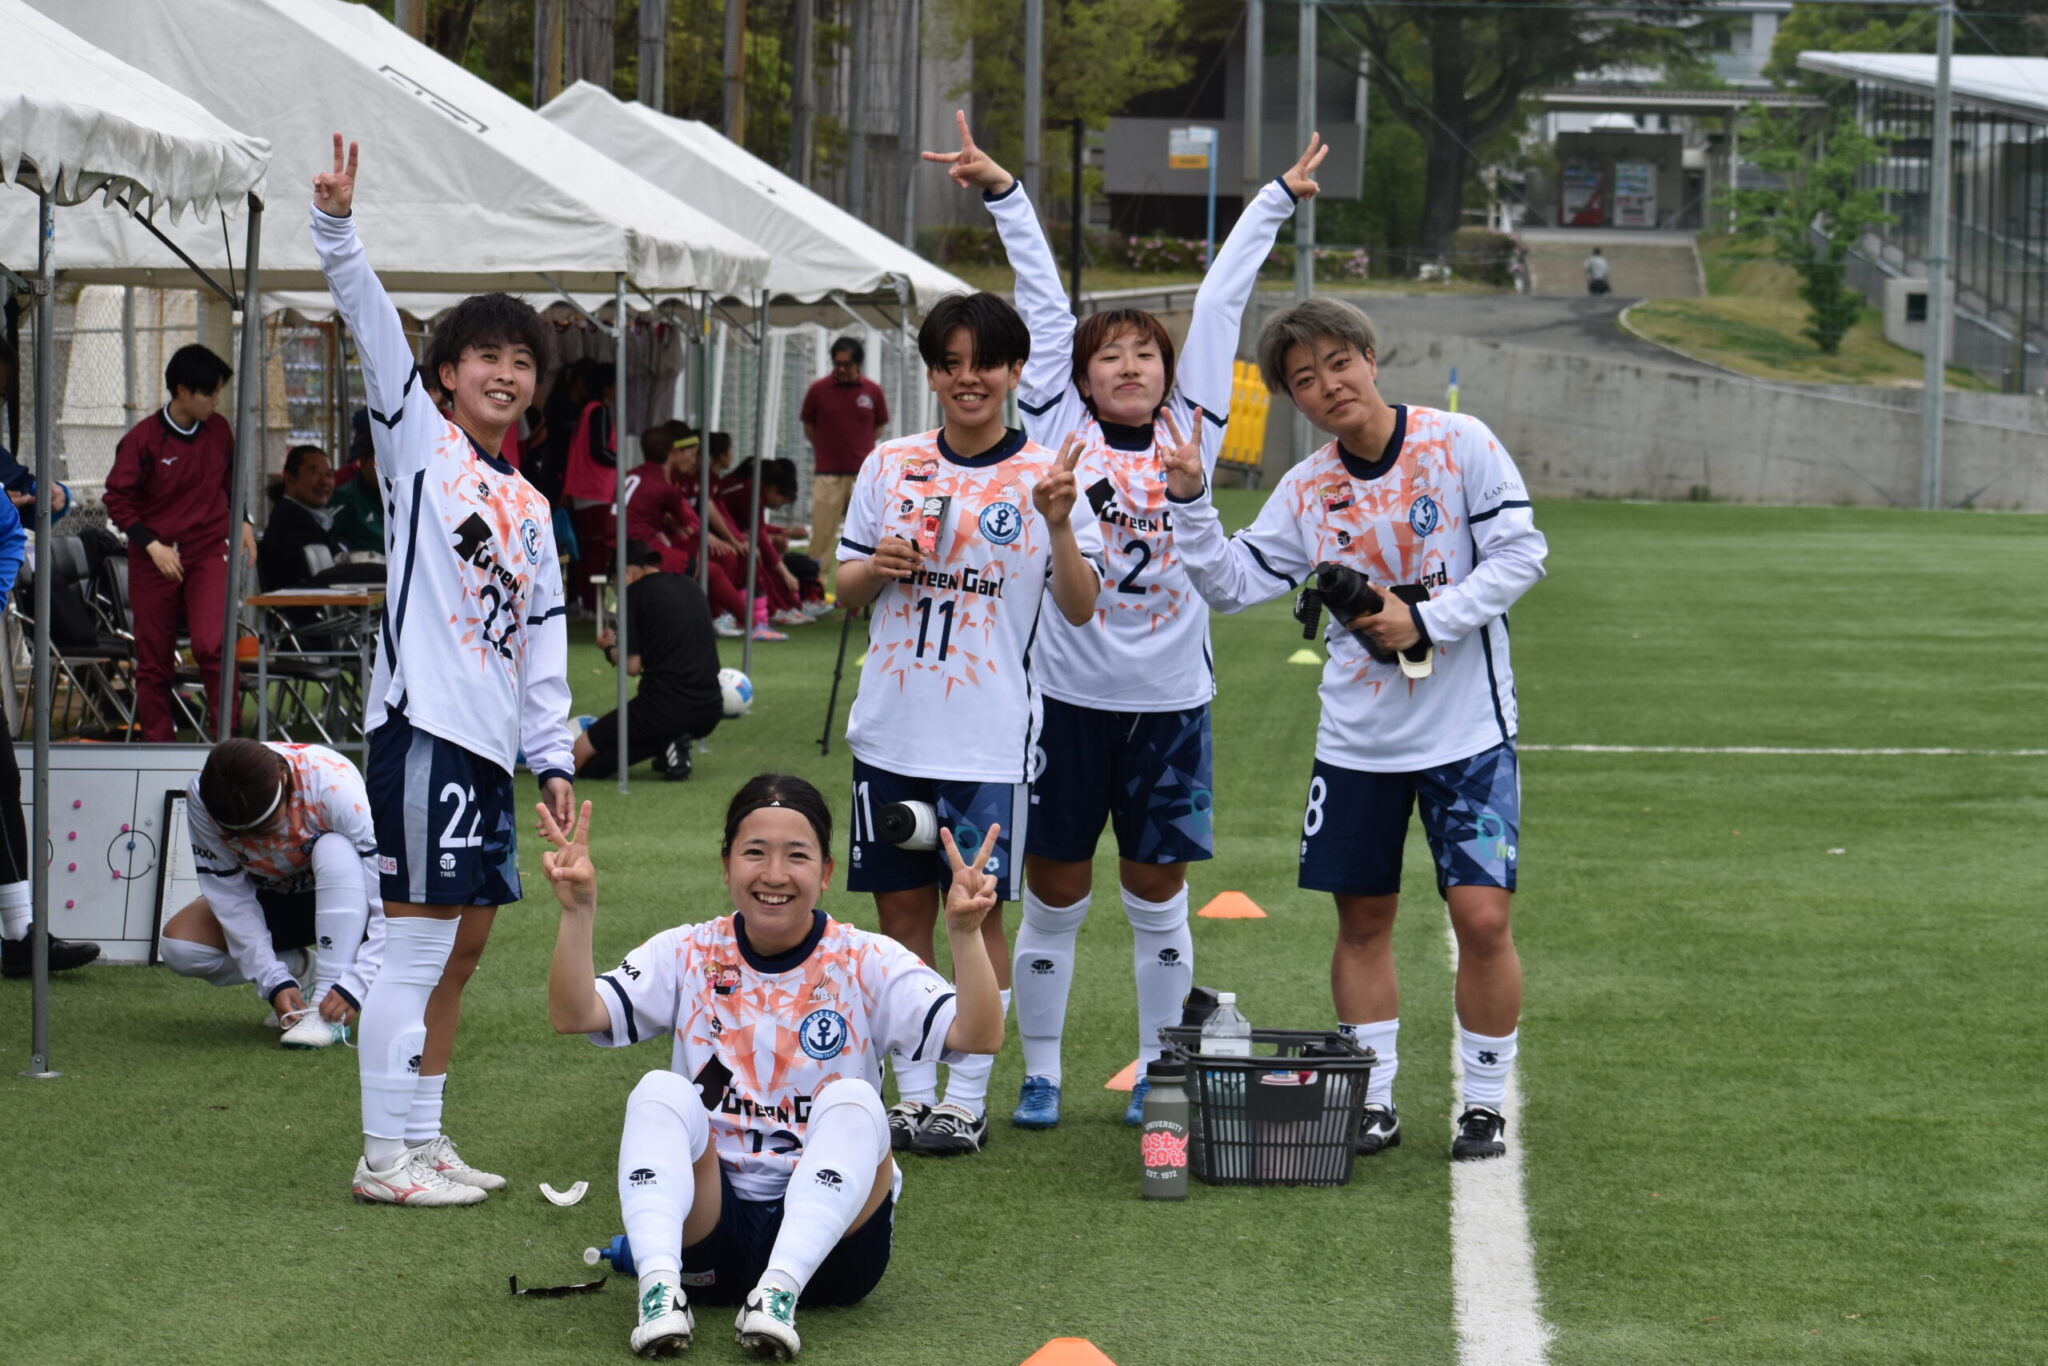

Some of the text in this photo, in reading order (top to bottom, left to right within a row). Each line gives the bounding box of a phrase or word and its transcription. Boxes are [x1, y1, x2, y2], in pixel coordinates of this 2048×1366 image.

[1117, 539, 1151, 594] 2
[1422, 561, 1447, 589] ard
[916, 597, 955, 661] 11
[439, 782, 483, 849] 22
[853, 780, 875, 843] 11
[1303, 775, 1327, 837] 8
